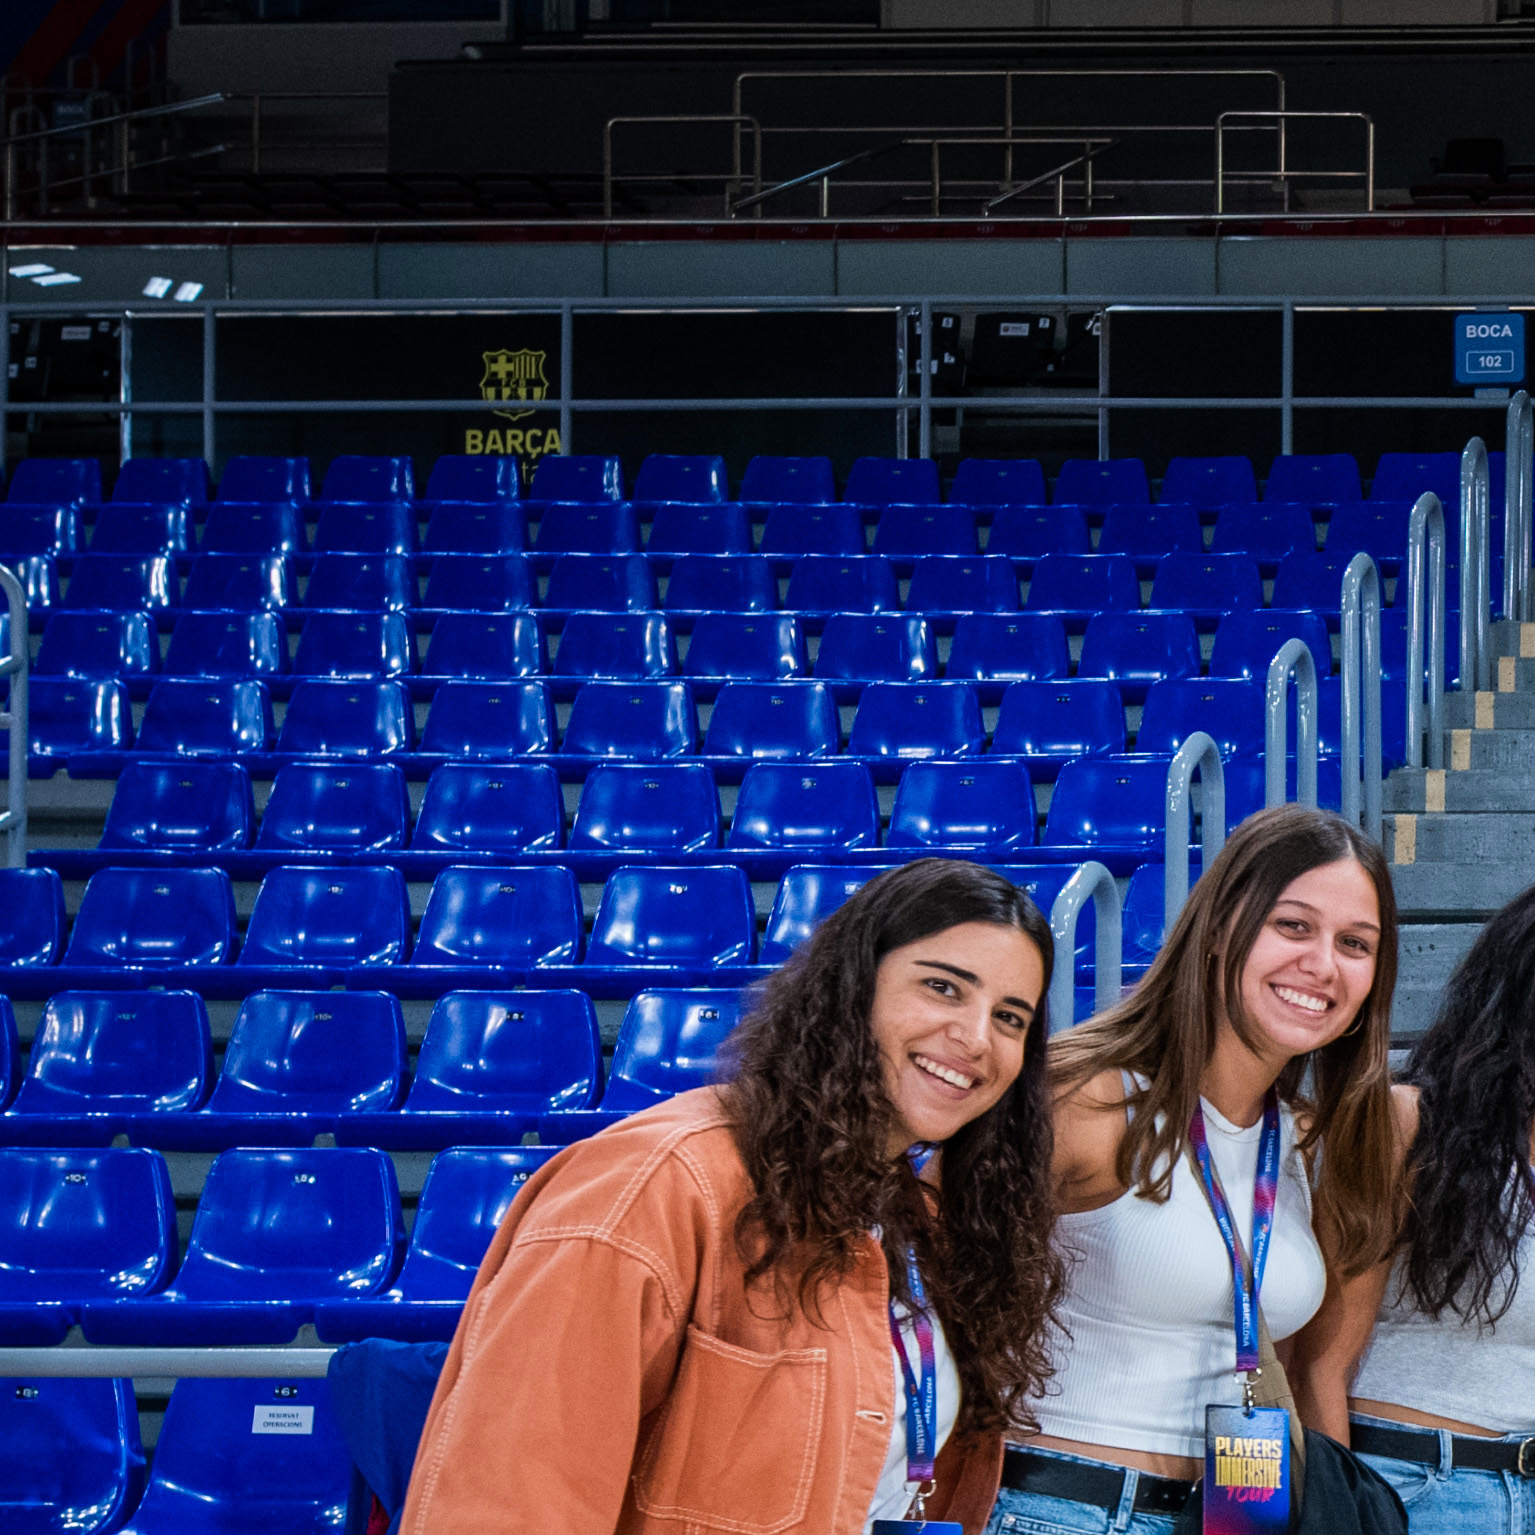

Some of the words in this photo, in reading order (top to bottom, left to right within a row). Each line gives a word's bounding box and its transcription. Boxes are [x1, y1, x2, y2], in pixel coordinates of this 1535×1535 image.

[1465, 325, 1513, 338] BOCA
[1478, 356, 1502, 368] 102
[464, 427, 561, 459] BARÇA
[1242, 1301, 1251, 1347] BARCELONA
[914, 1407, 925, 1455] BARCELONA
[1215, 1436, 1282, 1458] PLAYERS
[1215, 1456, 1282, 1488] IMMERSIVE
[1225, 1486, 1275, 1503] TOUR
